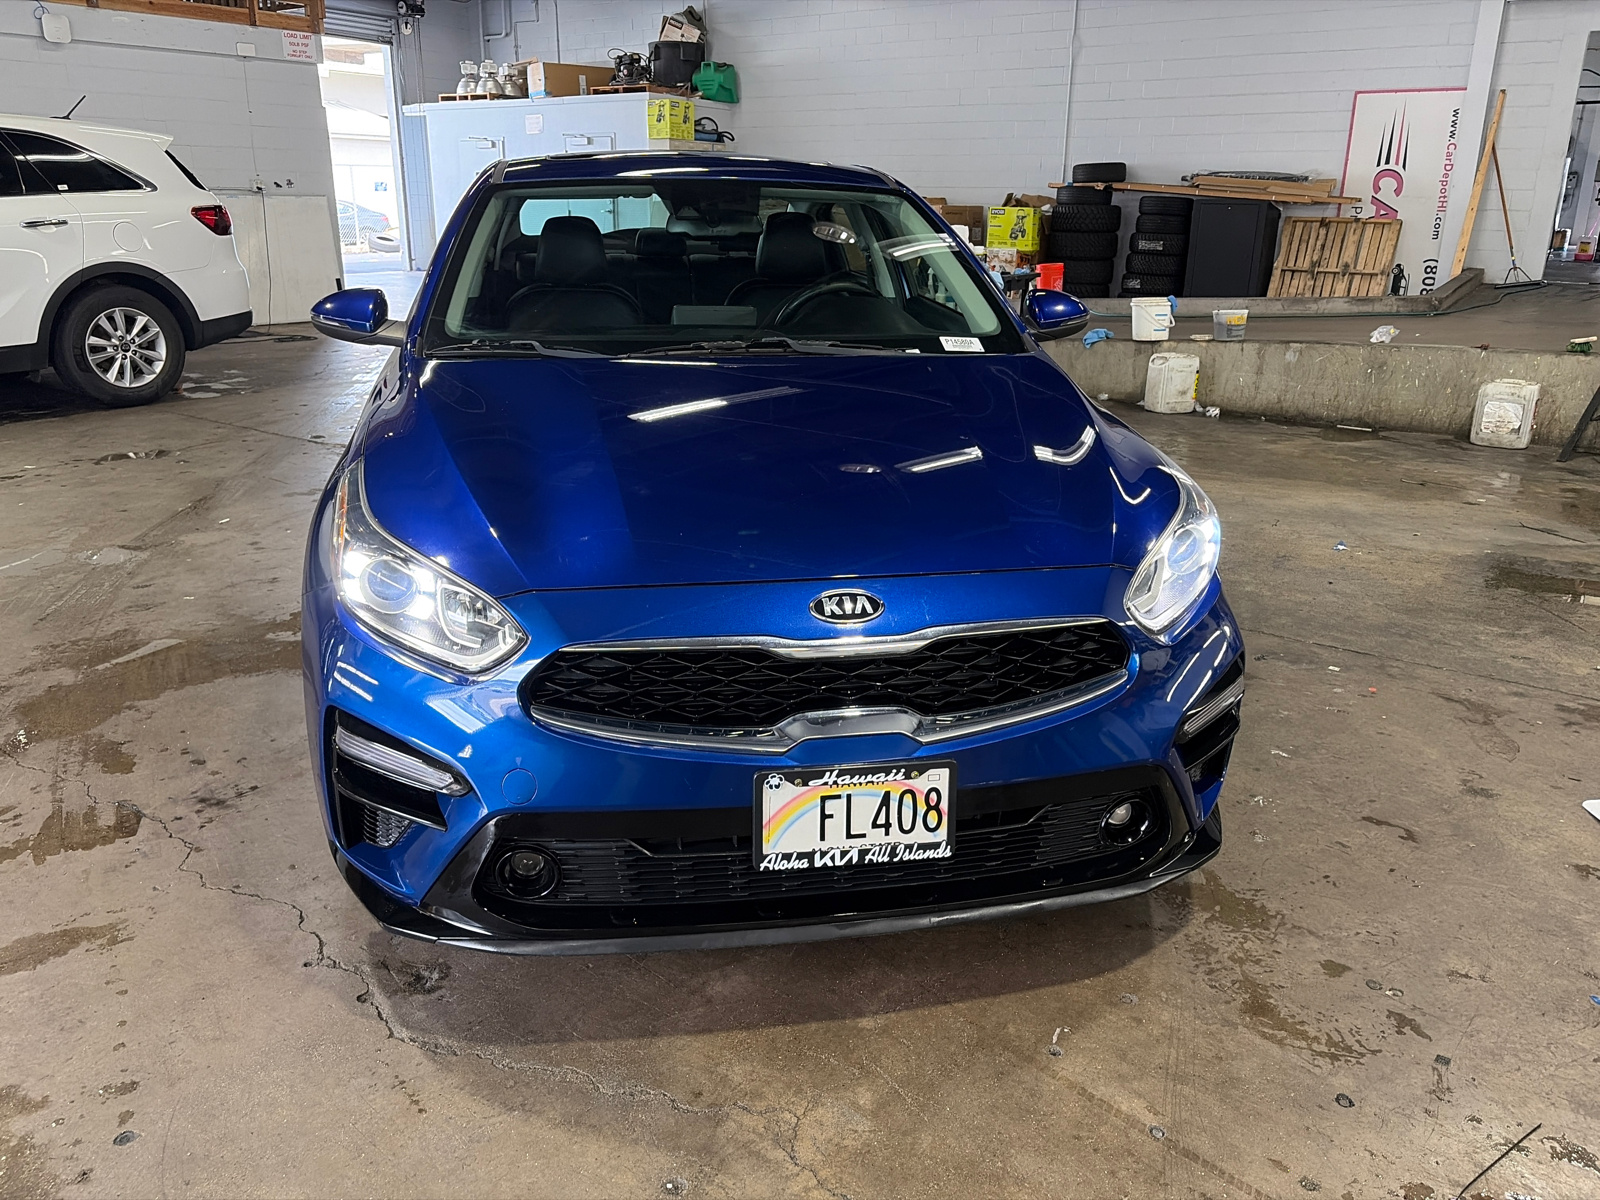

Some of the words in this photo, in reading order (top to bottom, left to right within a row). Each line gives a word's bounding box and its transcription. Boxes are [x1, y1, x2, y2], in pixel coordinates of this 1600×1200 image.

[1431, 108, 1460, 240] www.CarDepotHI.com
[822, 597, 874, 616] KIA
[808, 768, 906, 786] Hawaii
[759, 852, 809, 872] Aloha
[864, 849, 890, 864] All
[893, 840, 952, 862] Islands
